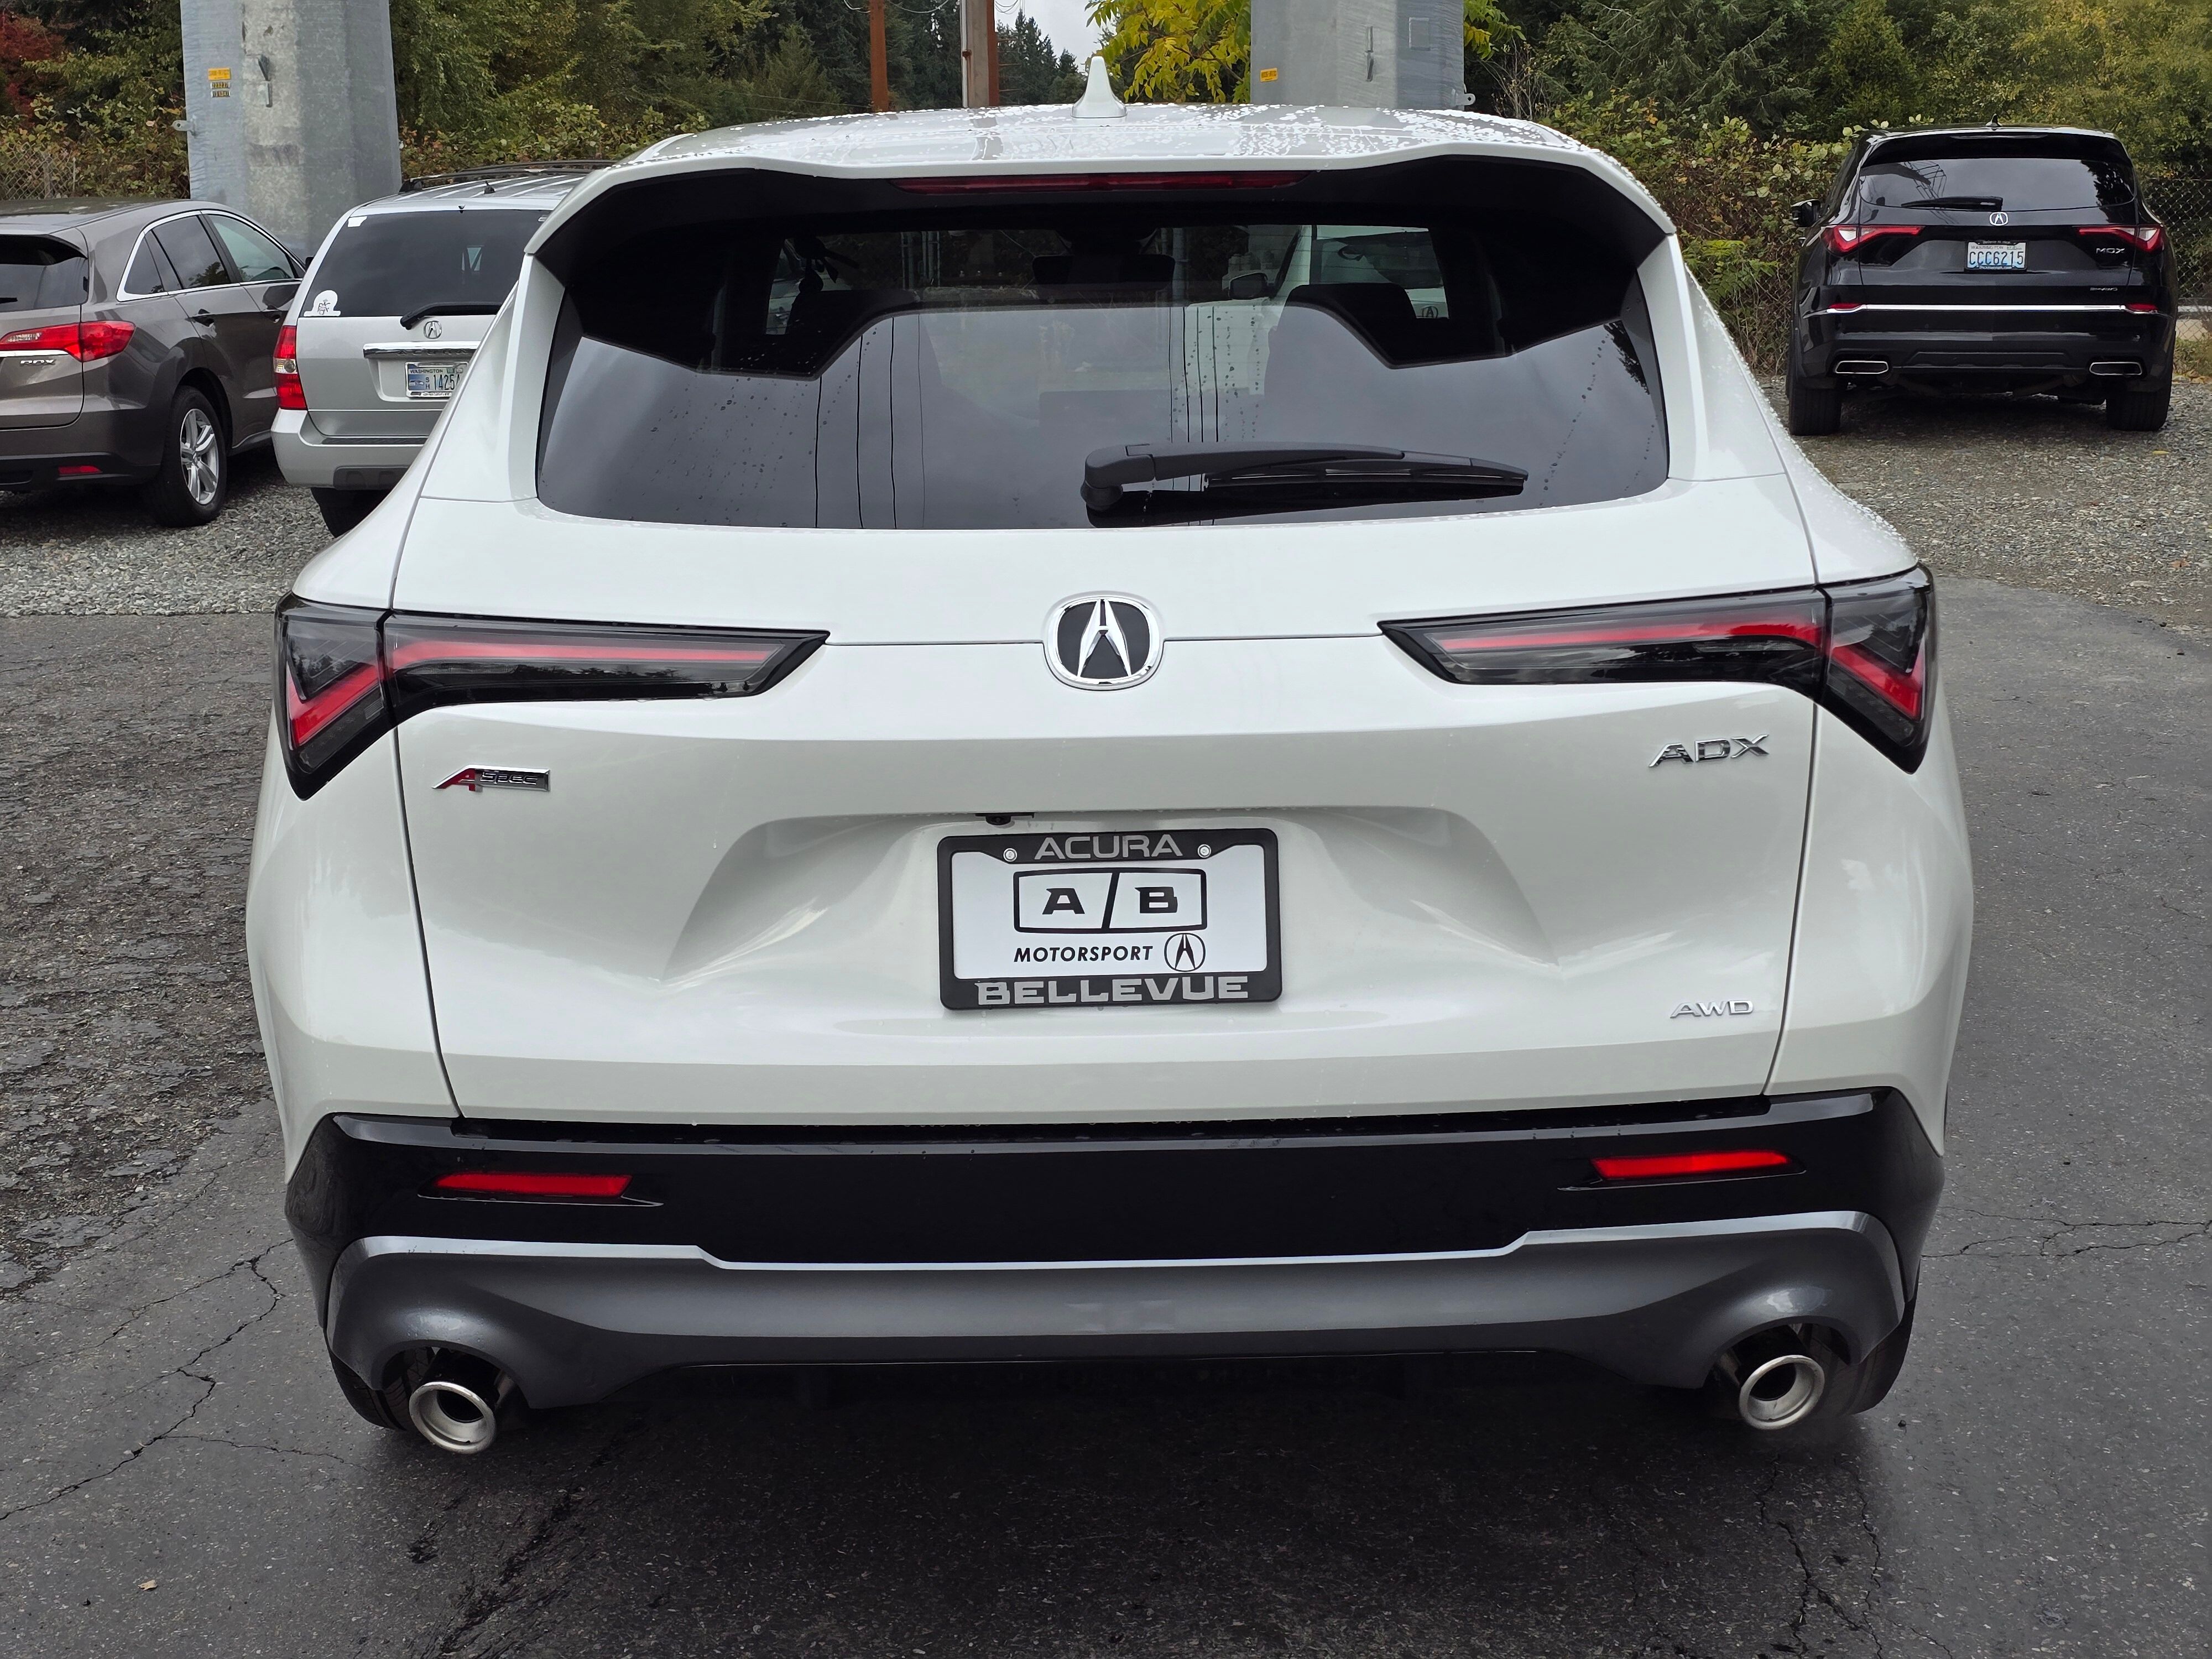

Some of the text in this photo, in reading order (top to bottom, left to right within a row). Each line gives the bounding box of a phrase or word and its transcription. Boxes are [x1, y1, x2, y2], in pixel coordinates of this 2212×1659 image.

[1969, 251, 2024, 265] CCC6215
[1648, 734, 1770, 768] ADX
[1034, 834, 1183, 860] ACURA
[1042, 886, 1178, 915] A B
[1014, 945, 1154, 962] MOTORSPORT
[975, 975, 1249, 1005] BELLEVUE
[1670, 999, 1754, 1019] AWD
